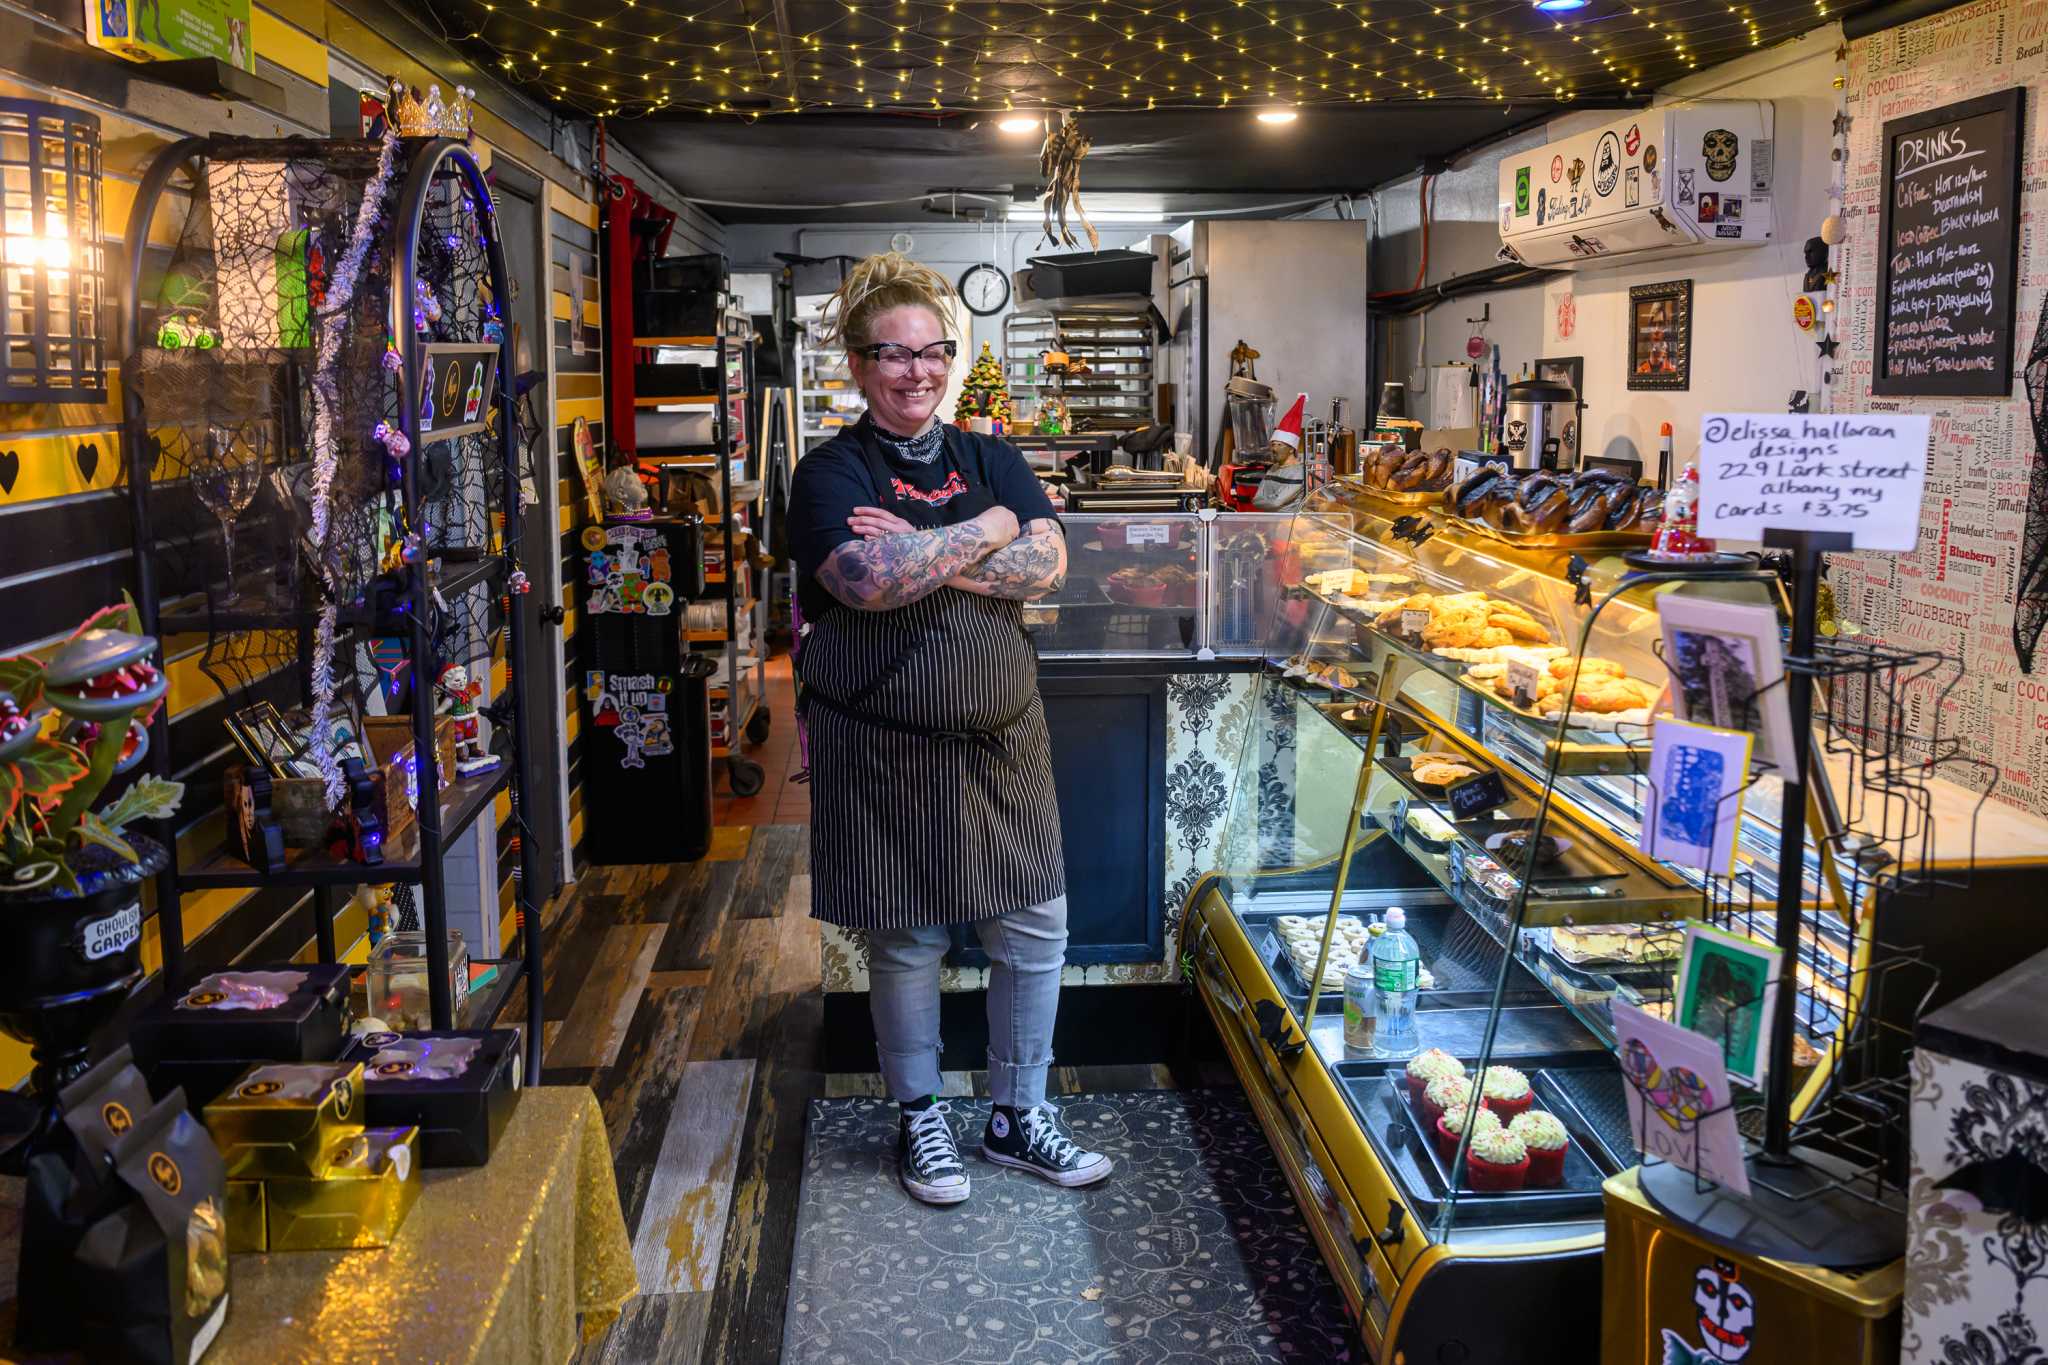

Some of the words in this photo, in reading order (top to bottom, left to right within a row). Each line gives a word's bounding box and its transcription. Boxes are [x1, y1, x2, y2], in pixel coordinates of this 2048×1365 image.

[1898, 127, 1967, 174] DRINKS
[1916, 250, 1935, 268] HOT
[1749, 441, 1838, 462] designs
[1974, 418, 1984, 466] VANILLA
[1719, 462, 1768, 480] 229
[1777, 461, 1832, 478] Lark
[1840, 461, 1919, 479] street
[1760, 480, 1839, 500] albany
[1850, 487, 1883, 501] ny
[1953, 445, 1963, 507] cupcake
[1986, 481, 1997, 538] PUDDING
[1935, 498, 1952, 583] blueberry
[1949, 545, 1997, 568] Blueberry
[2004, 546, 2016, 605] Breakfast
[1861, 587, 1874, 626] Truffle
[1891, 577, 1903, 633] chocolate
[1900, 598, 1971, 630] BLUEBERRY
[1906, 693, 1921, 736] Truffle
[1958, 688, 1968, 735] VANILLA
[2005, 767, 2031, 787] truffle
[2032, 732, 2042, 791] CARAMEL
[2001, 781, 2040, 806] BANANA
[92, 923, 140, 954] GARDEN
